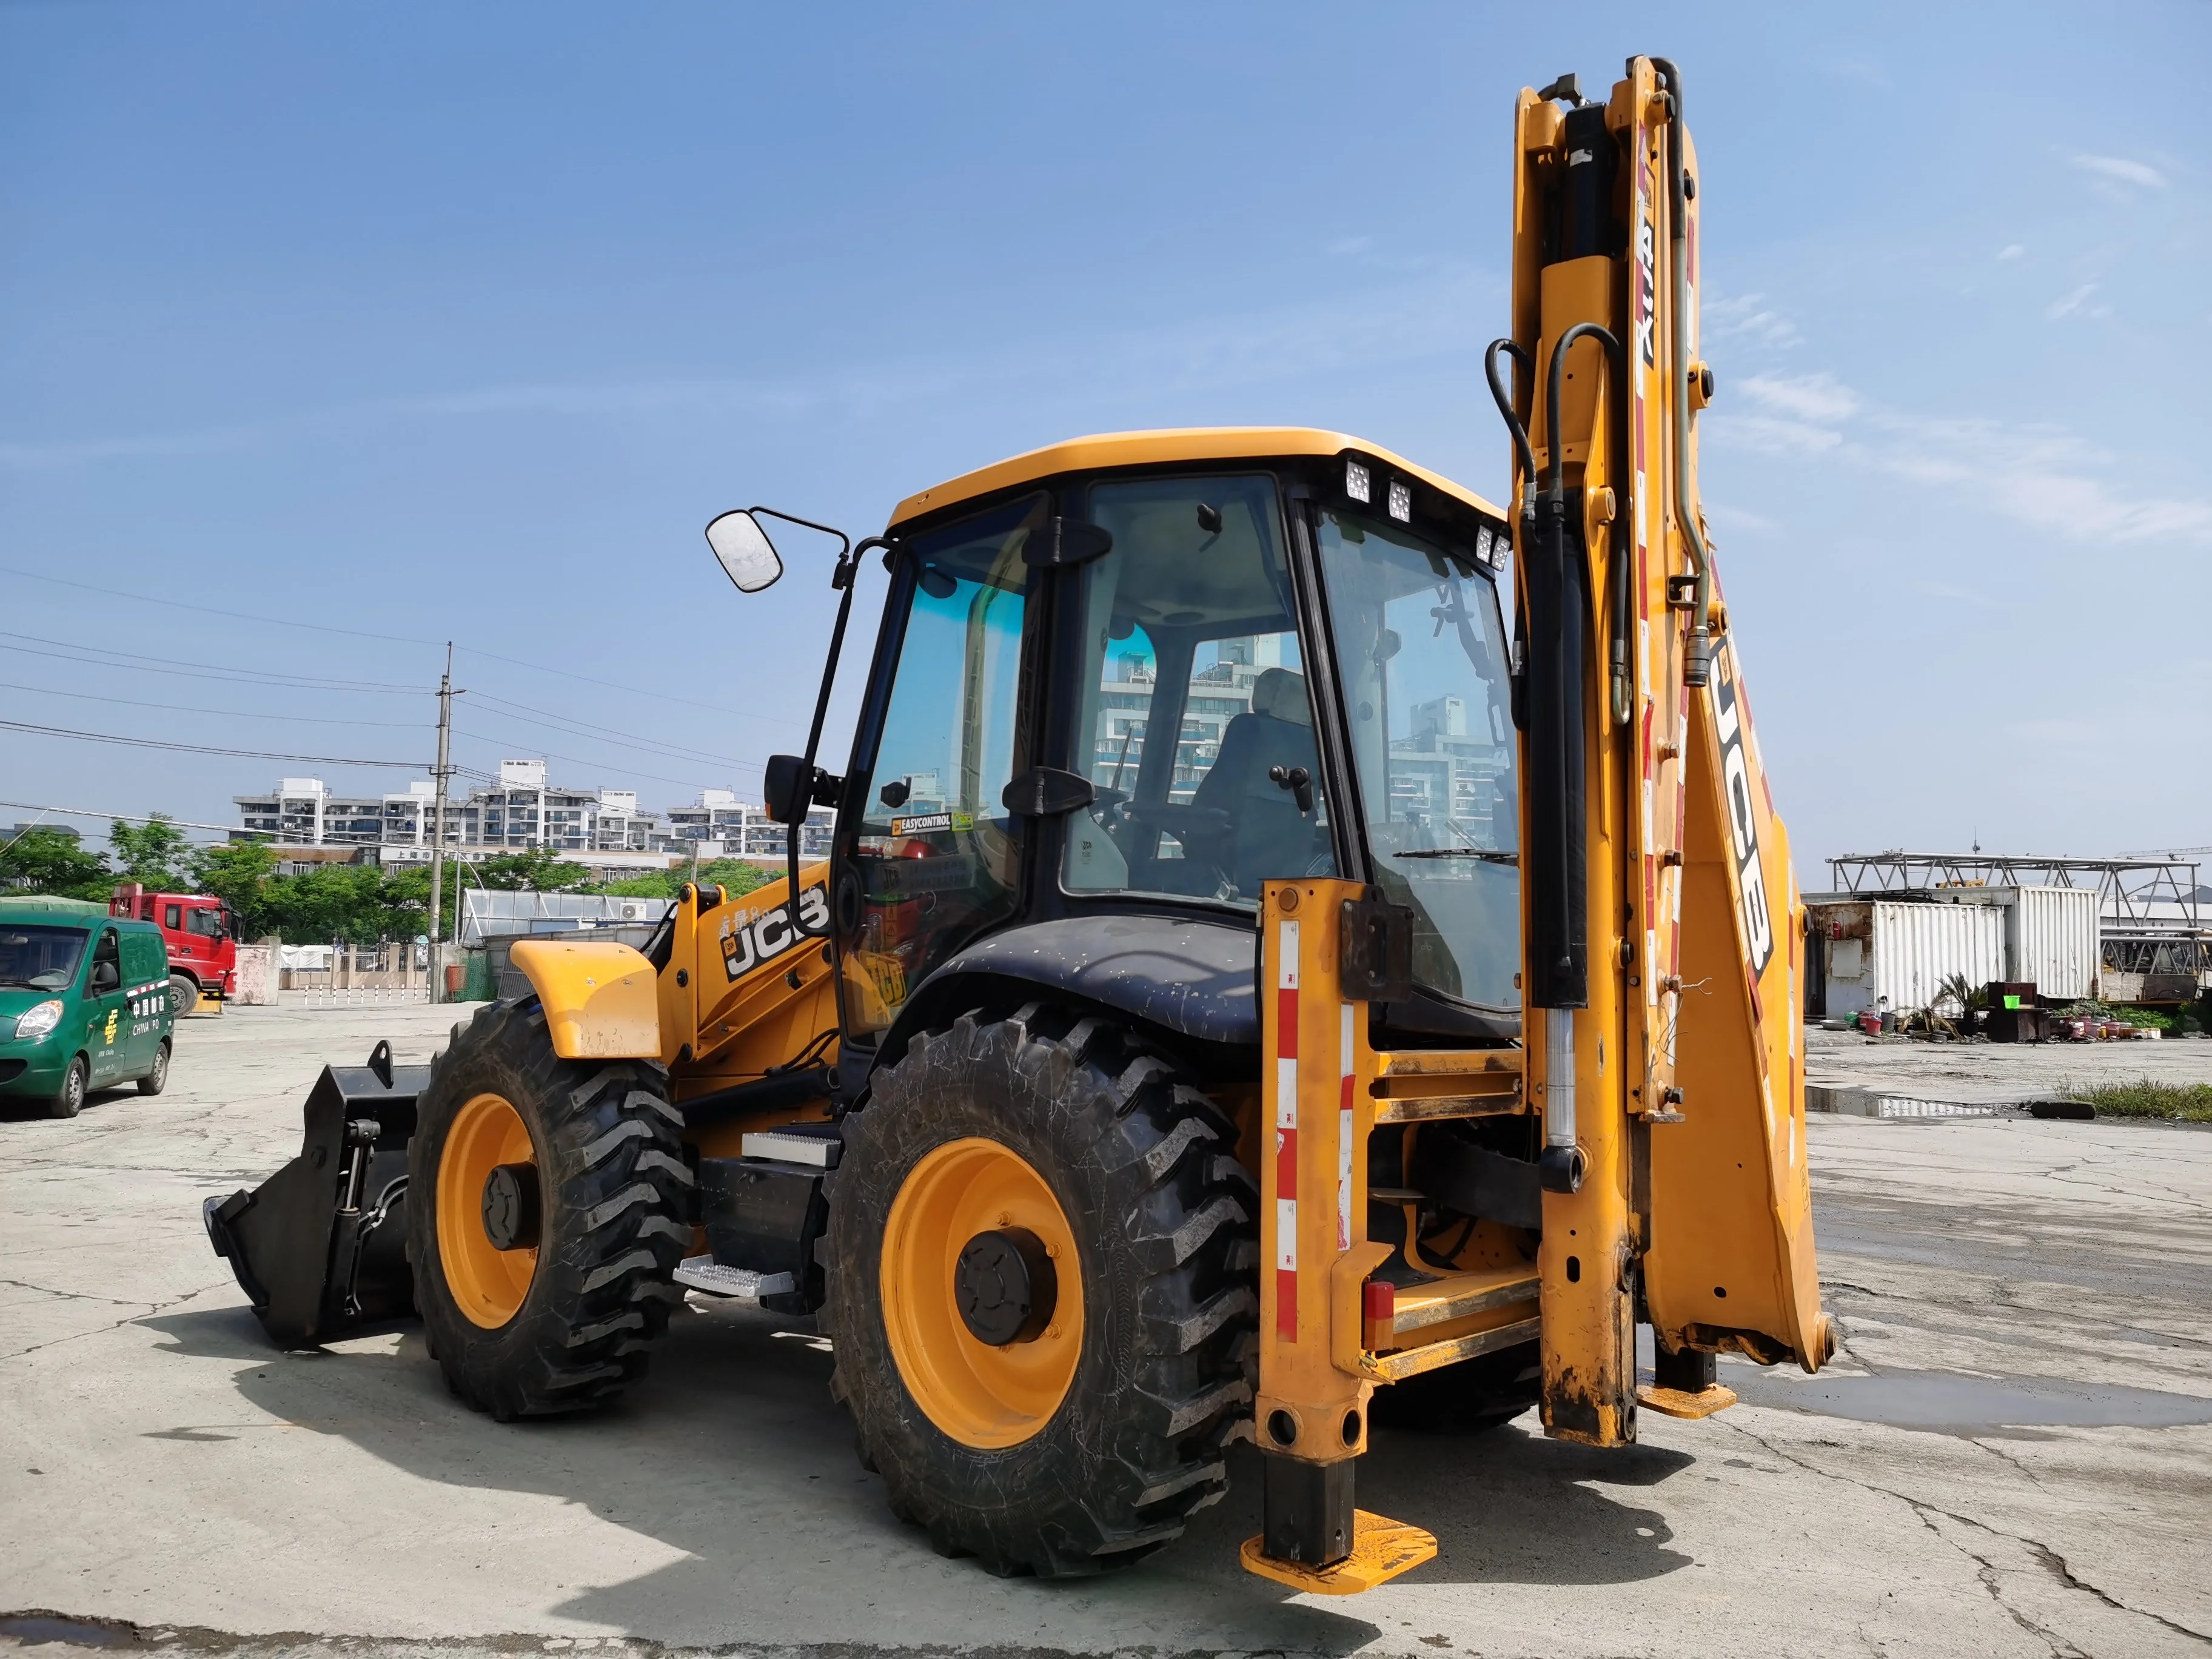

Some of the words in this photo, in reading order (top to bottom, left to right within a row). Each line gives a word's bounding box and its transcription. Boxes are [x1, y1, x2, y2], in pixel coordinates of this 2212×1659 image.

[1711, 655, 1771, 970] JCB
[902, 816, 951, 833] EASYCONTROL
[728, 888, 830, 975] JCB
[1288, 973, 1293, 984] 3M
[133, 1022, 149, 1036] CHINA
[1287, 1113, 1291, 1124] 3M
[1286, 1255, 1291, 1265] 3M
